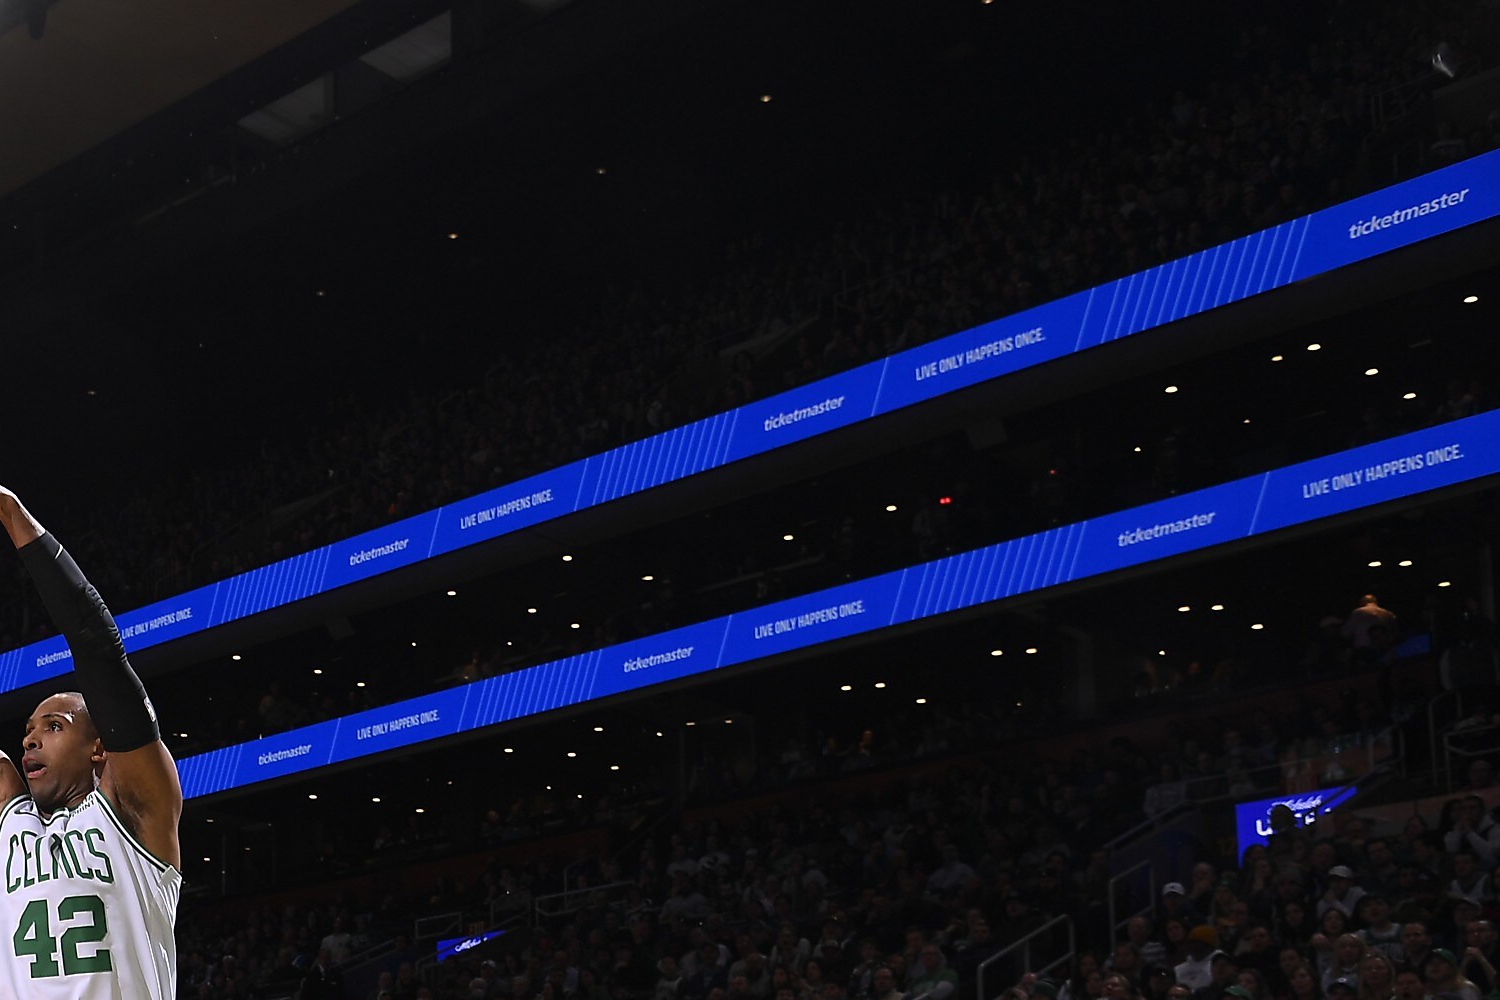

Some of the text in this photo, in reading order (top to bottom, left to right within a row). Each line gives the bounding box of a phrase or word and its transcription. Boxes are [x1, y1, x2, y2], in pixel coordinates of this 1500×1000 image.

[1349, 189, 1469, 238] ticketmaster
[916, 327, 1045, 381] LIVE ONLY HAPPENS ONCE.
[764, 396, 844, 431] ticketmaster
[1303, 444, 1464, 498] LIVE ONLY HAPPENS ONCE.
[461, 489, 553, 529] LIVE ONLY HAPPENS ONCE.
[1118, 512, 1215, 546] ticketmaster
[350, 539, 409, 565] ticketmaster
[121, 627, 134, 640] LIVE
[135, 623, 149, 636] ONLY
[149, 613, 175, 631] HAPPENS
[755, 600, 865, 639] LIVE ONLY HAPPENS ONCE.
[37, 649, 71, 667] ticketmas
[624, 647, 693, 672] ticketmaster
[357, 727, 371, 740] LIVE
[372, 723, 388, 736] ONLY
[390, 715, 419, 731] HAPPENS
[259, 745, 311, 765] ticketmaster
[13, 894, 113, 979] 42
